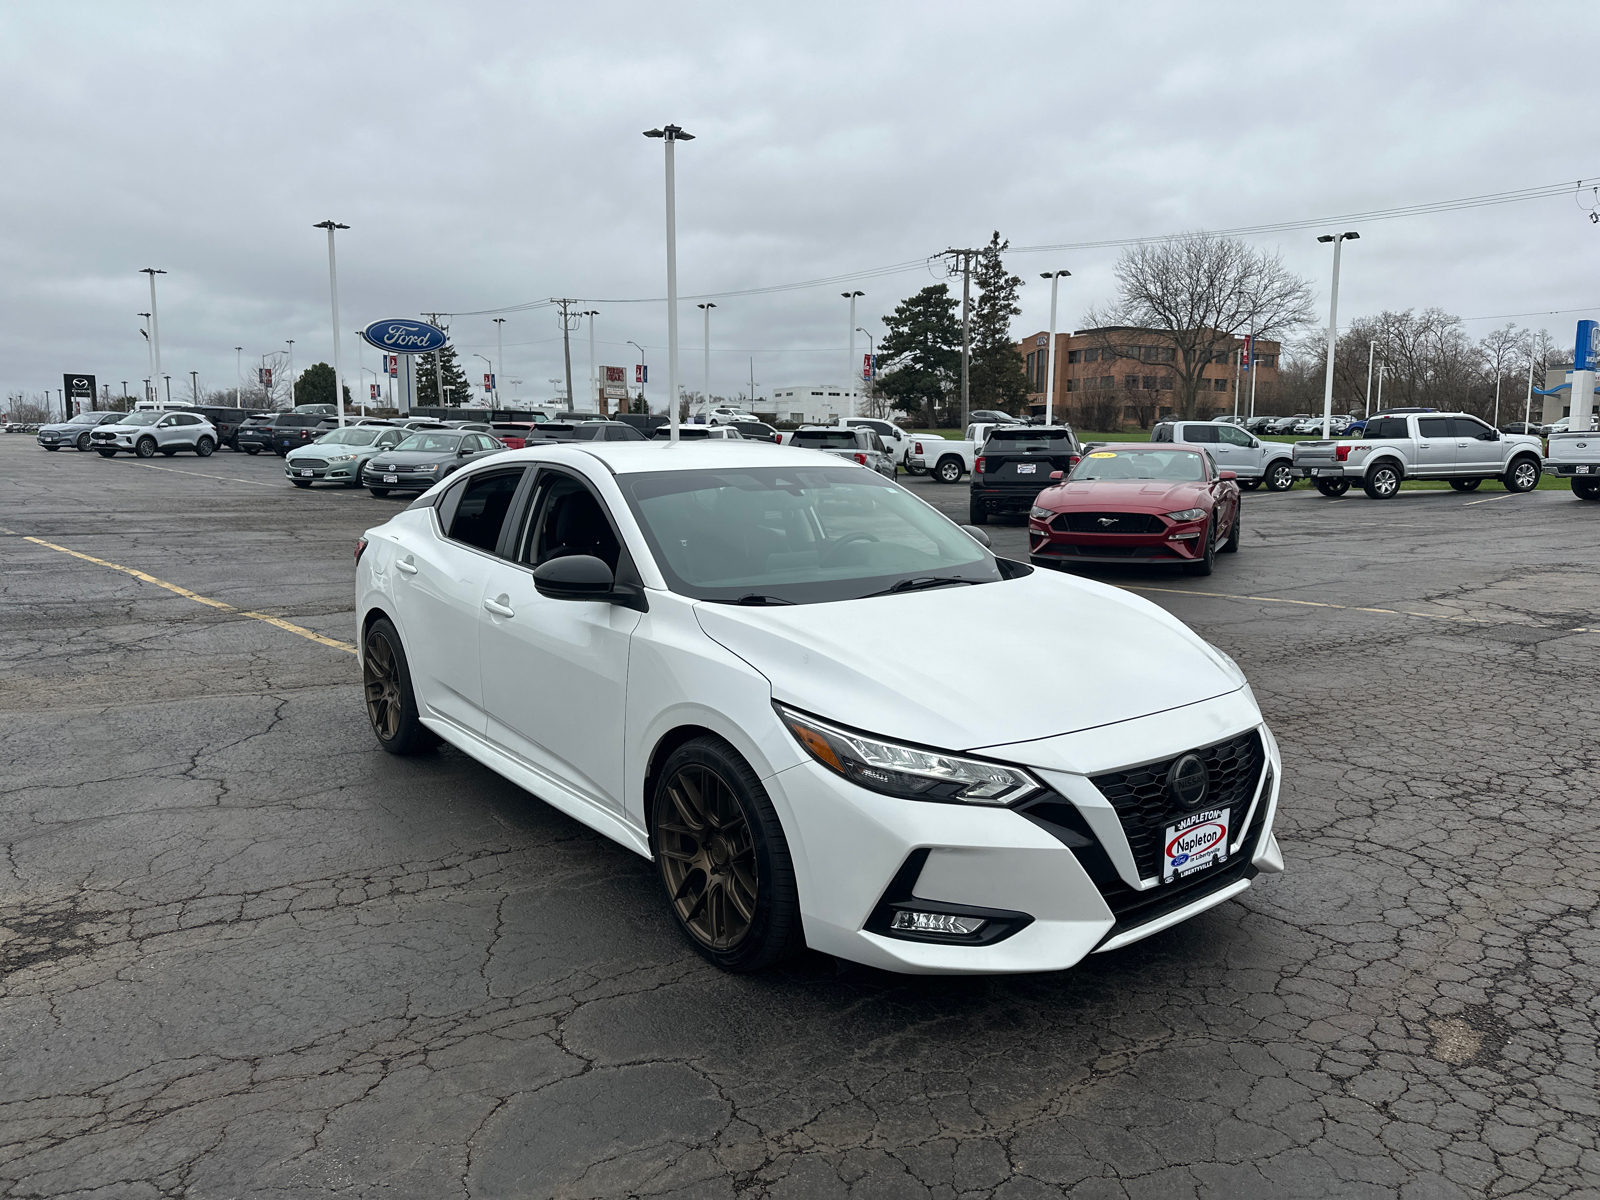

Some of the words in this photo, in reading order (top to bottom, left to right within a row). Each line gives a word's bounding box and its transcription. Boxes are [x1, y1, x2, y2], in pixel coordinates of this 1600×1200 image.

[384, 324, 431, 346] Ford
[1178, 774, 1205, 789] NISSAN
[1180, 810, 1220, 829] NAPLETON
[1176, 831, 1217, 854] Napleton
[1196, 848, 1221, 861] Libertyville
[1180, 861, 1213, 878] LIBERTYVILLE
